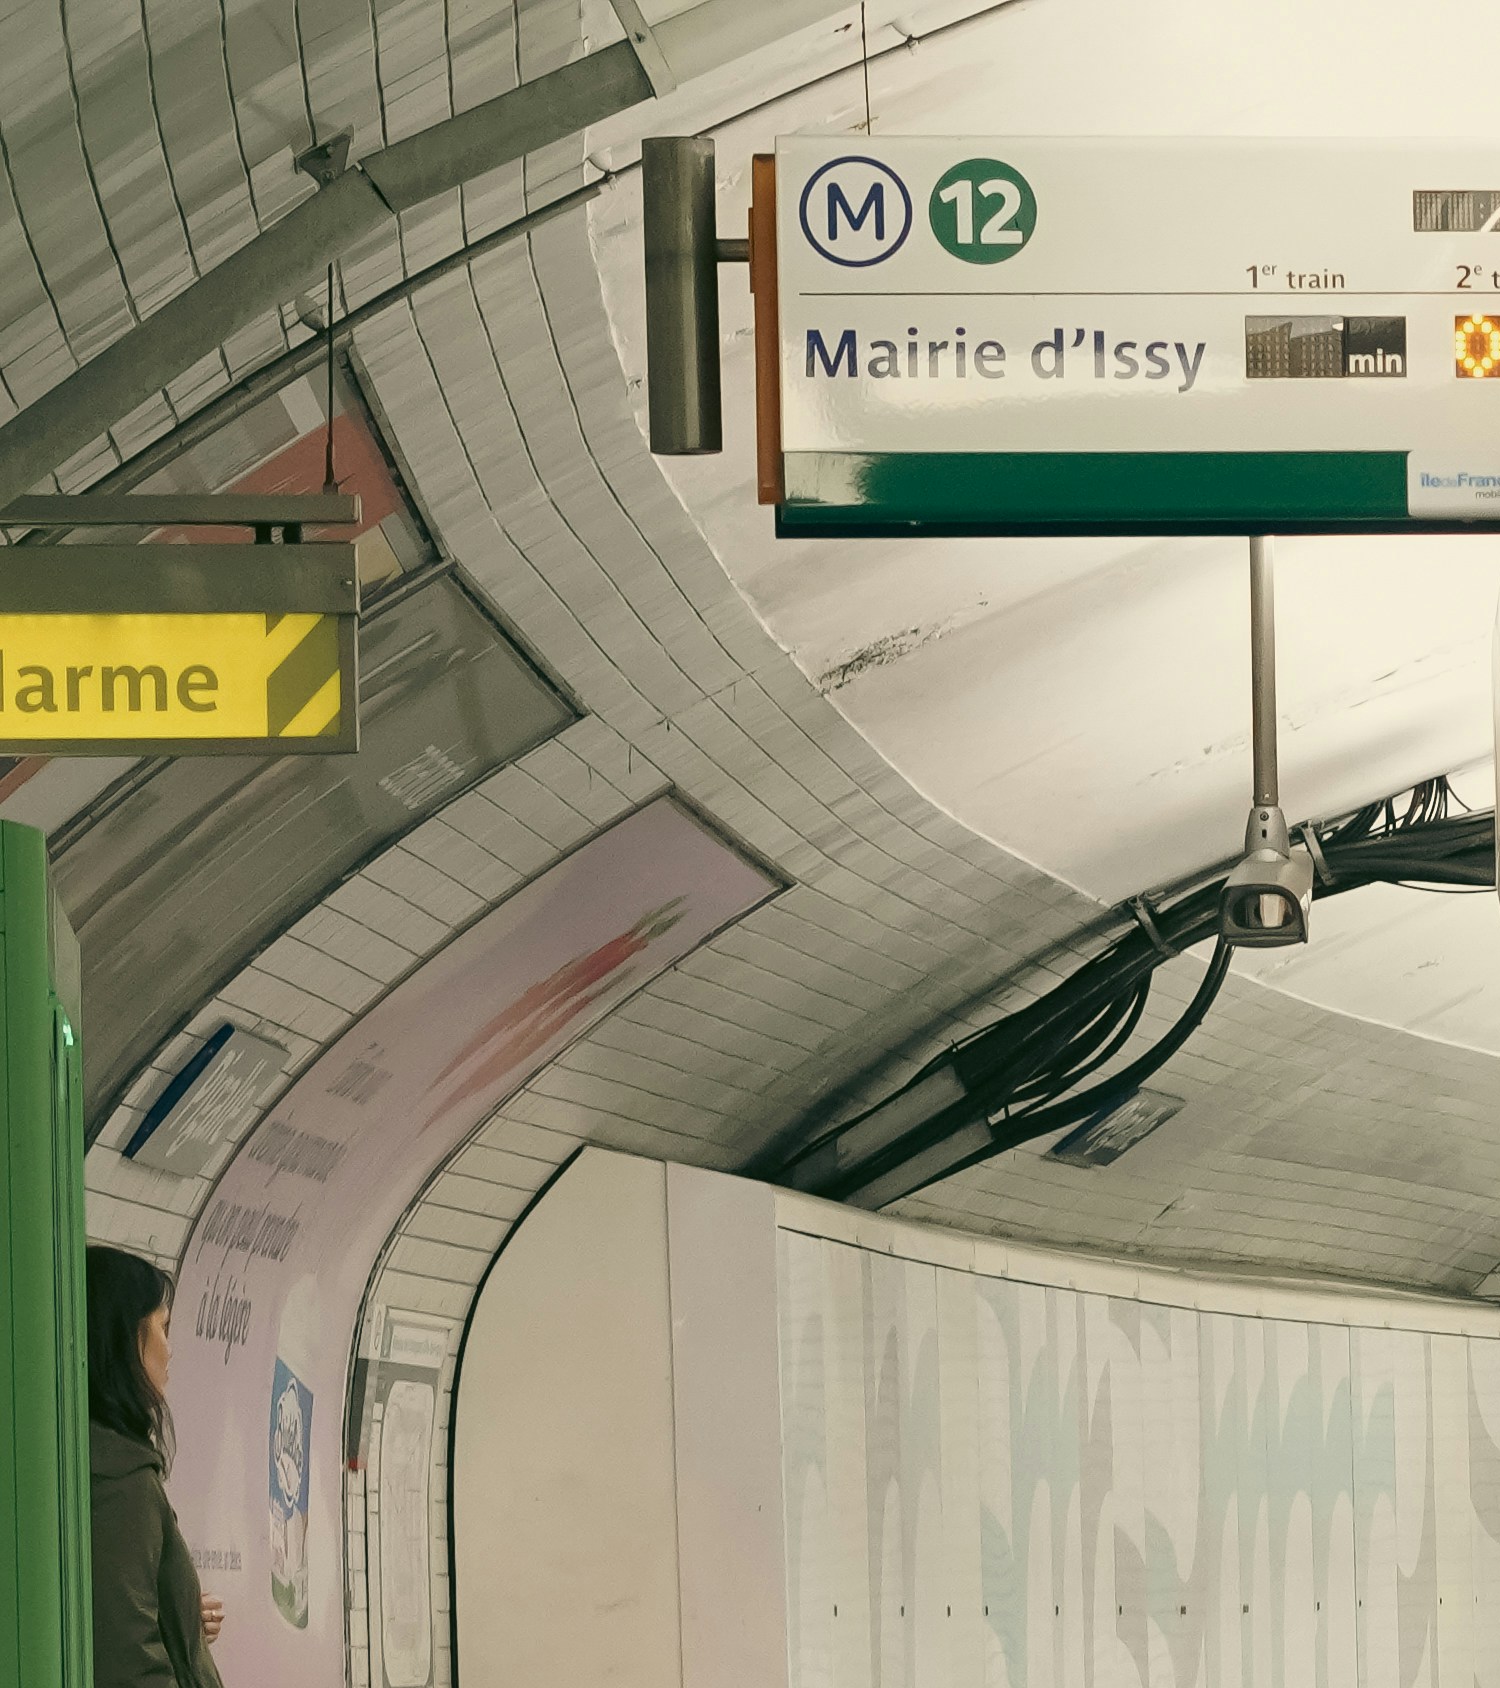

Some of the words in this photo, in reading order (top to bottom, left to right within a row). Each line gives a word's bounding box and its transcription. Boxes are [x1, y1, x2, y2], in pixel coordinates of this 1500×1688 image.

[827, 182, 884, 241] M
[939, 179, 1023, 244] 12
[1287, 267, 1345, 289] train
[805, 326, 1006, 379] Mairie
[1031, 328, 1207, 393] d’Issy
[1349, 348, 1403, 374] min
